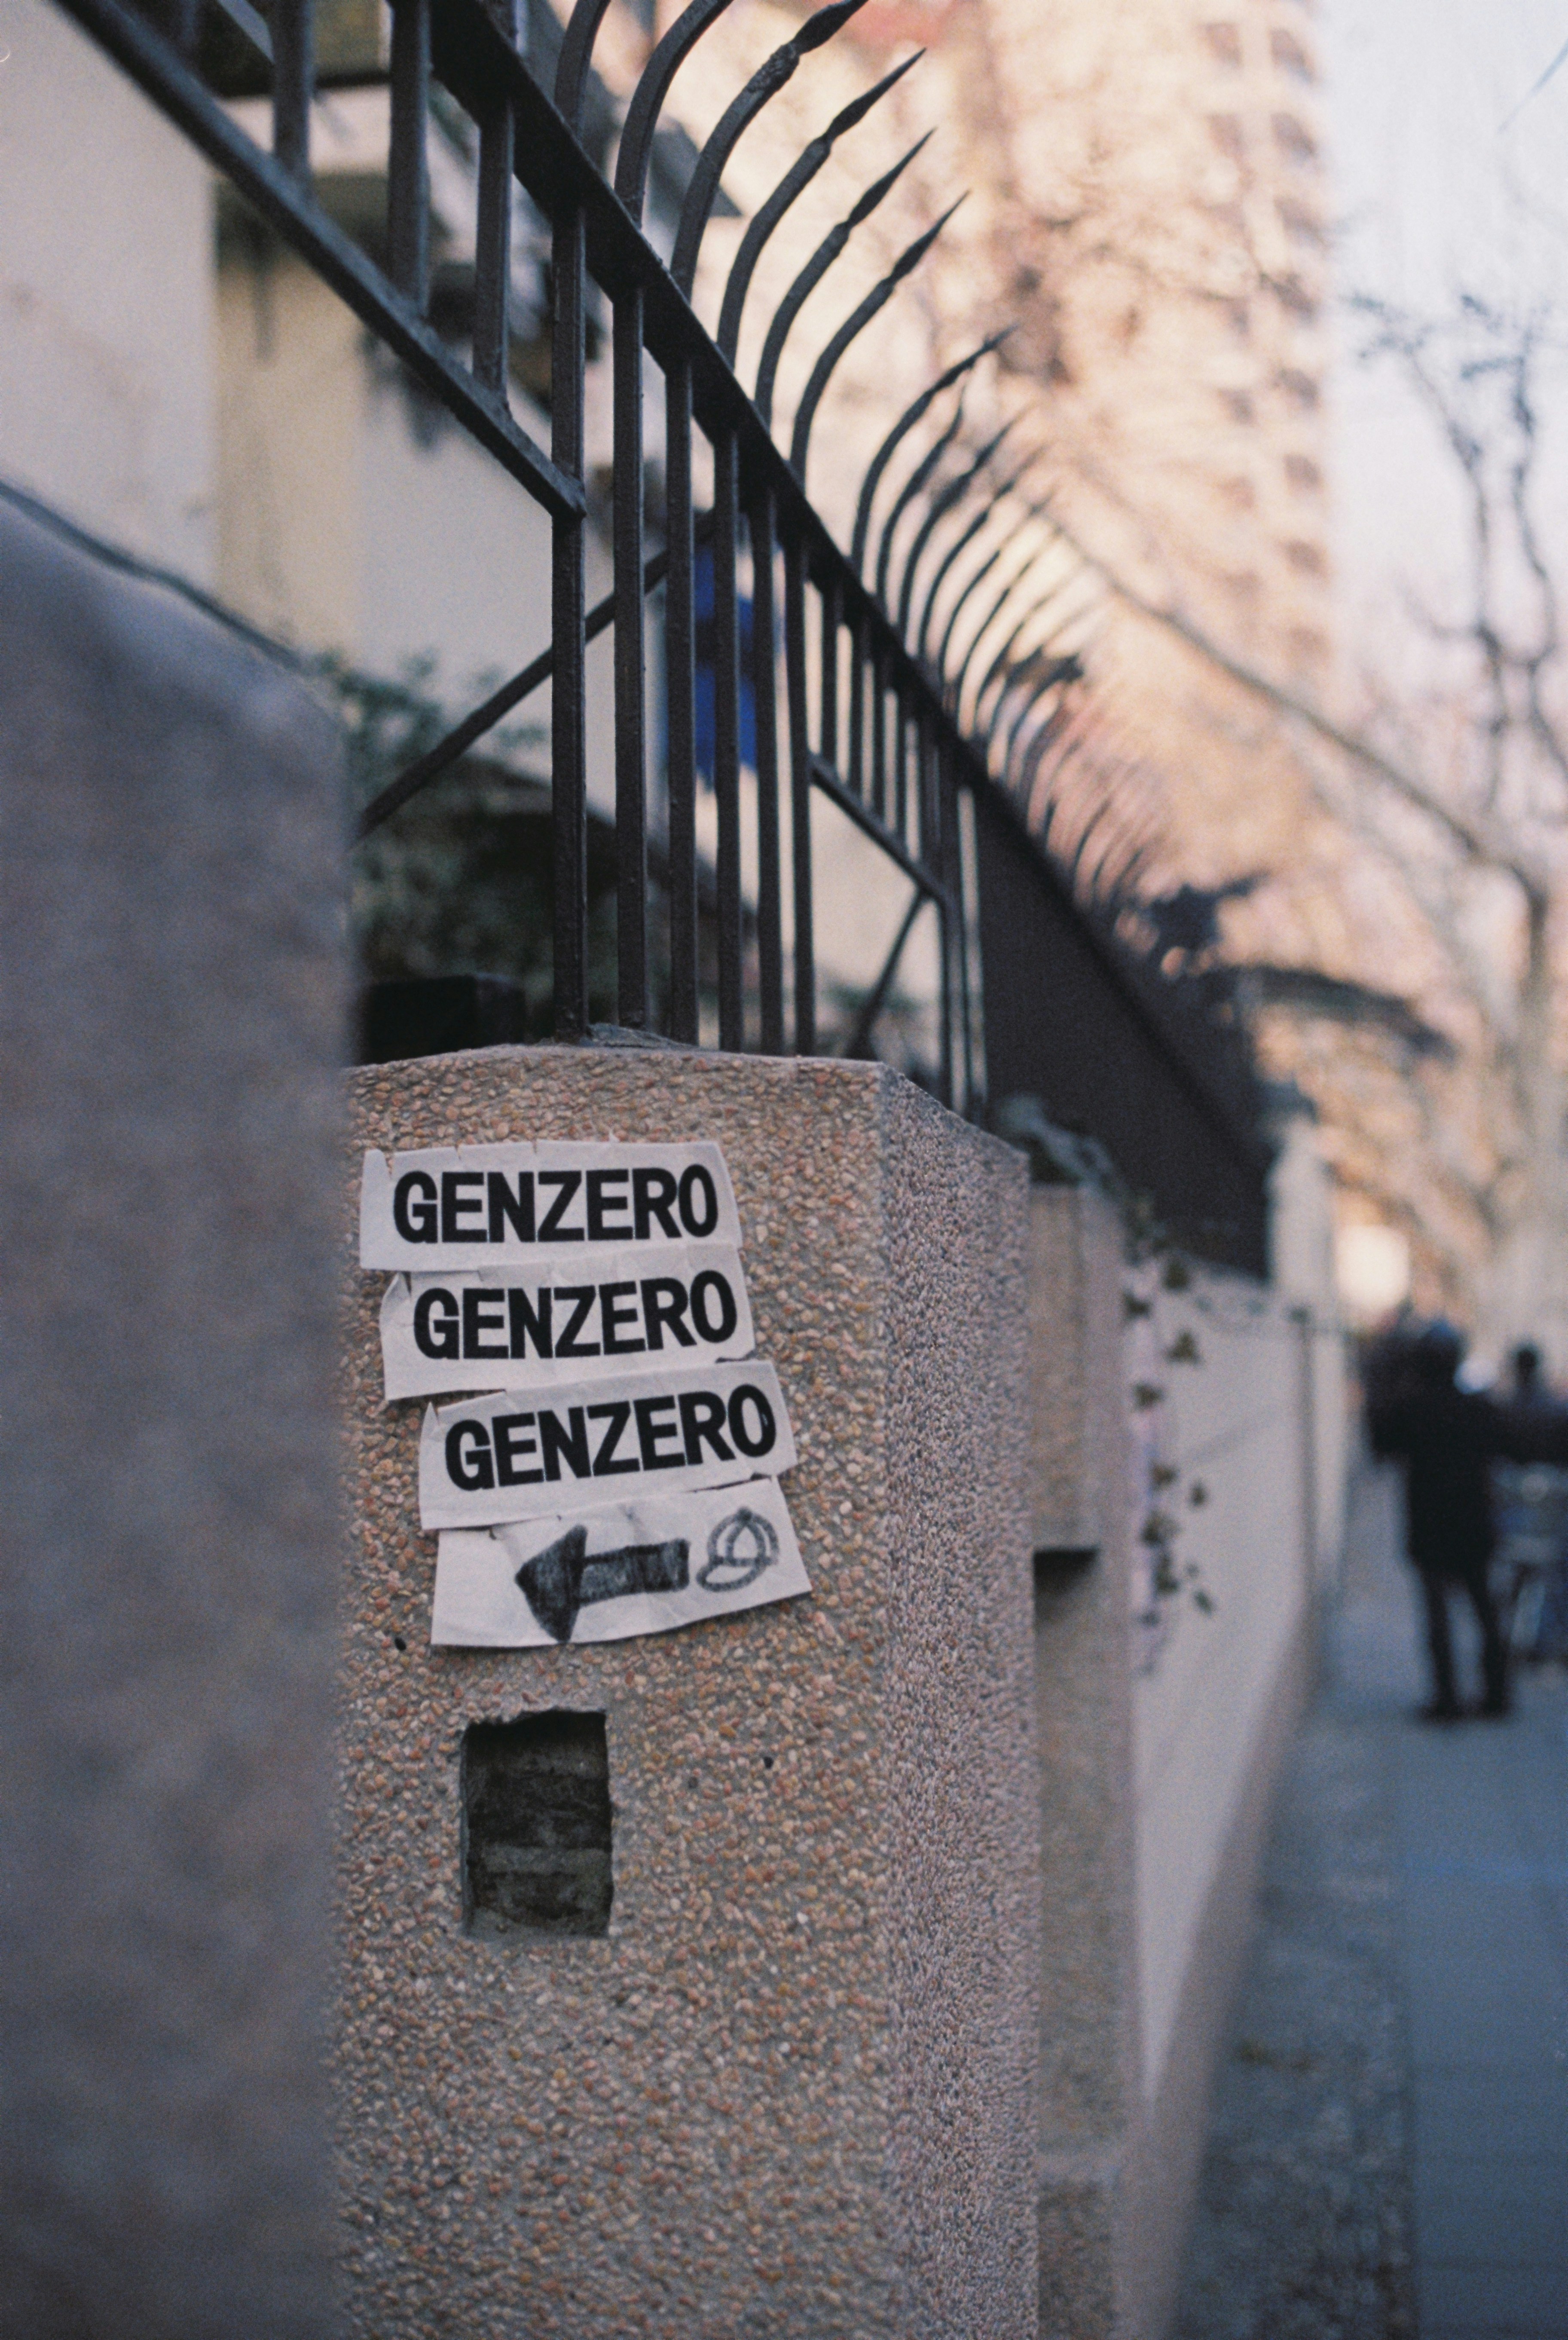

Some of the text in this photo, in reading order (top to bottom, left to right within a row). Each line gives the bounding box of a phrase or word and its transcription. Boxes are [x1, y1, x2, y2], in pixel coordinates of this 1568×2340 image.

[393, 1164, 718, 1244] GENZERO
[413, 1270, 737, 1360] GENZERO
[445, 1384, 776, 1491] GENZERO
